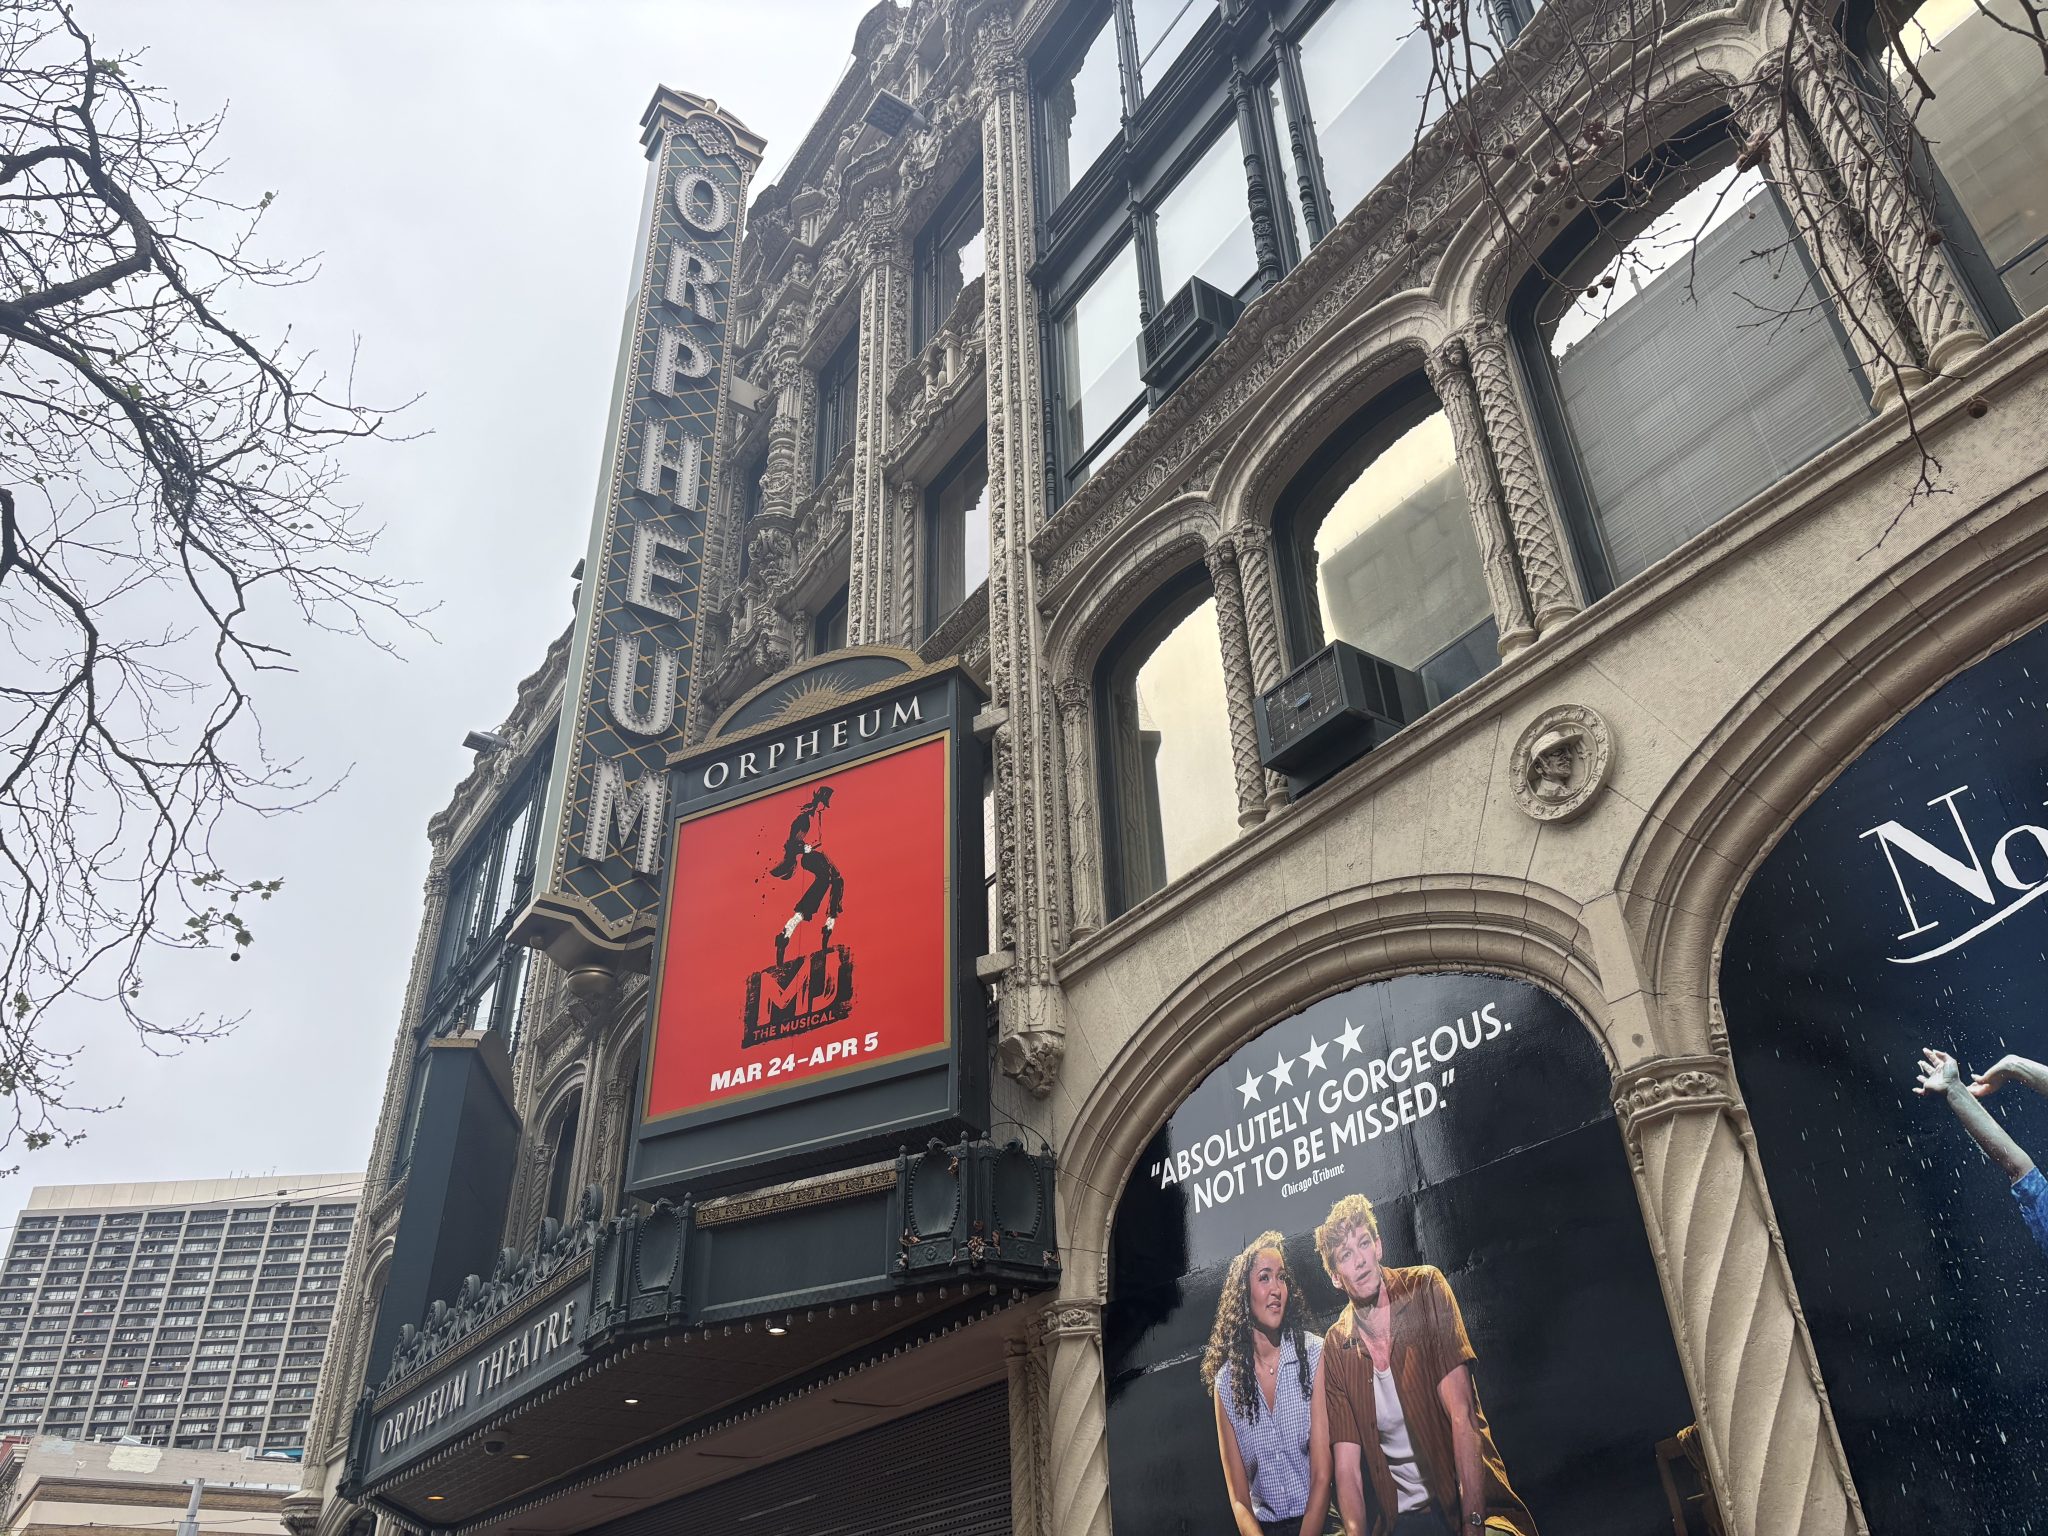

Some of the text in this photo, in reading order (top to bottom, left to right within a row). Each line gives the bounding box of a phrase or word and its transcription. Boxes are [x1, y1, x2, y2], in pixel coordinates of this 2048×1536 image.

[582, 166, 732, 875] ORPHEUM
[702, 695, 925, 790] ORPHEUM
[1858, 785, 2048, 940] No
[753, 1010, 836, 1041] THE MUSICAL
[756, 950, 840, 1027] MJ
[709, 1062, 763, 1092] MAR
[864, 1031, 879, 1052] 5
[1150, 1001, 1513, 1190] “ABSOLUTELY GORGEOUS.
[1193, 1068, 1455, 1214] NOT TO BE MISSED.”
[1281, 1163, 1345, 1198] Chicago Tribune
[380, 1300, 577, 1454] ORPHEUM THEATRE
